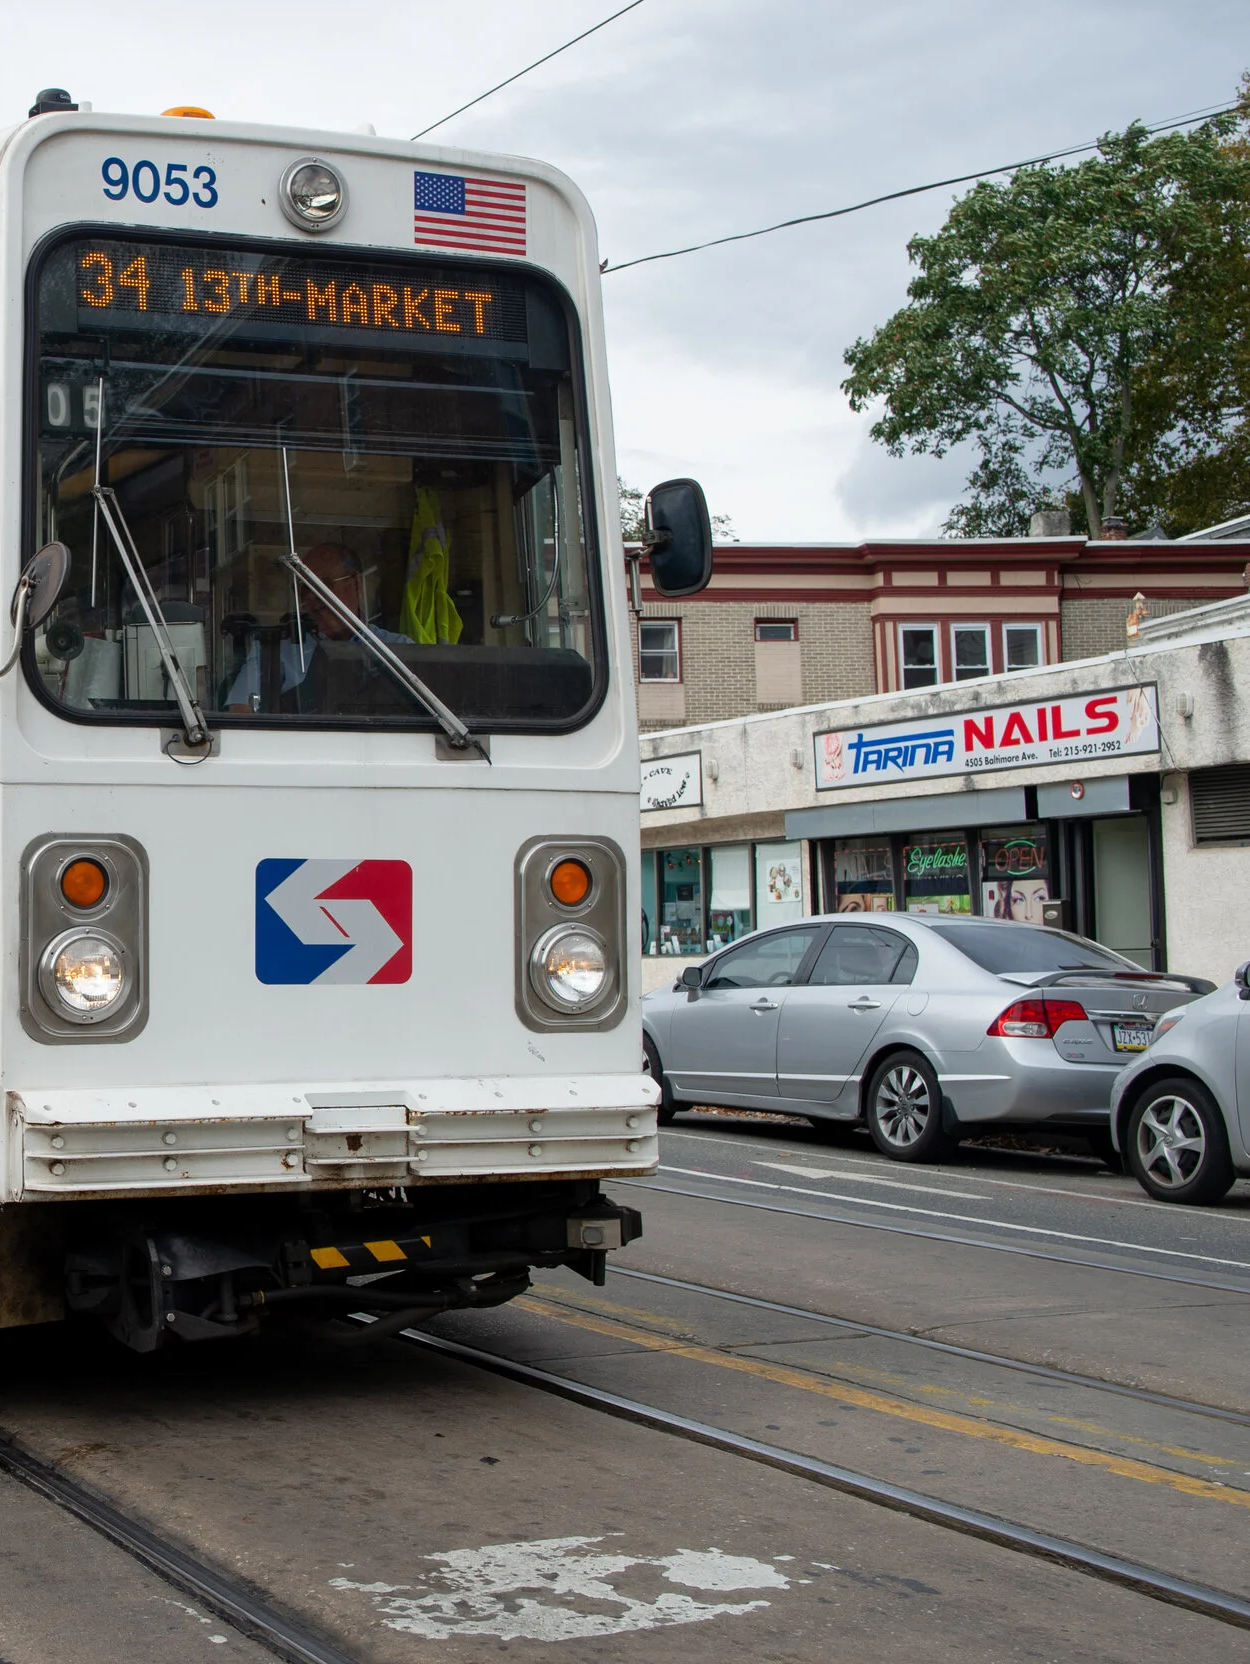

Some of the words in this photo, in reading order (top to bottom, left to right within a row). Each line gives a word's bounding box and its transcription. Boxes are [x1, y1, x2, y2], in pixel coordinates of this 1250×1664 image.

[102, 157, 218, 209] 9053
[81, 251, 150, 311] 34
[182, 267, 492, 334] 13TH-MARKET
[848, 729, 954, 773] TARINA
[964, 696, 1119, 752] NAILS
[965, 757, 983, 768] 4505
[985, 753, 1019, 766] Baltimore
[1021, 751, 1038, 761] Ave.
[1049, 748, 1062, 758] Tel:
[1065, 740, 1121, 757] 215-921-2952
[649, 767, 672, 777] CAVE
[995, 846, 1045, 872] OPEN
